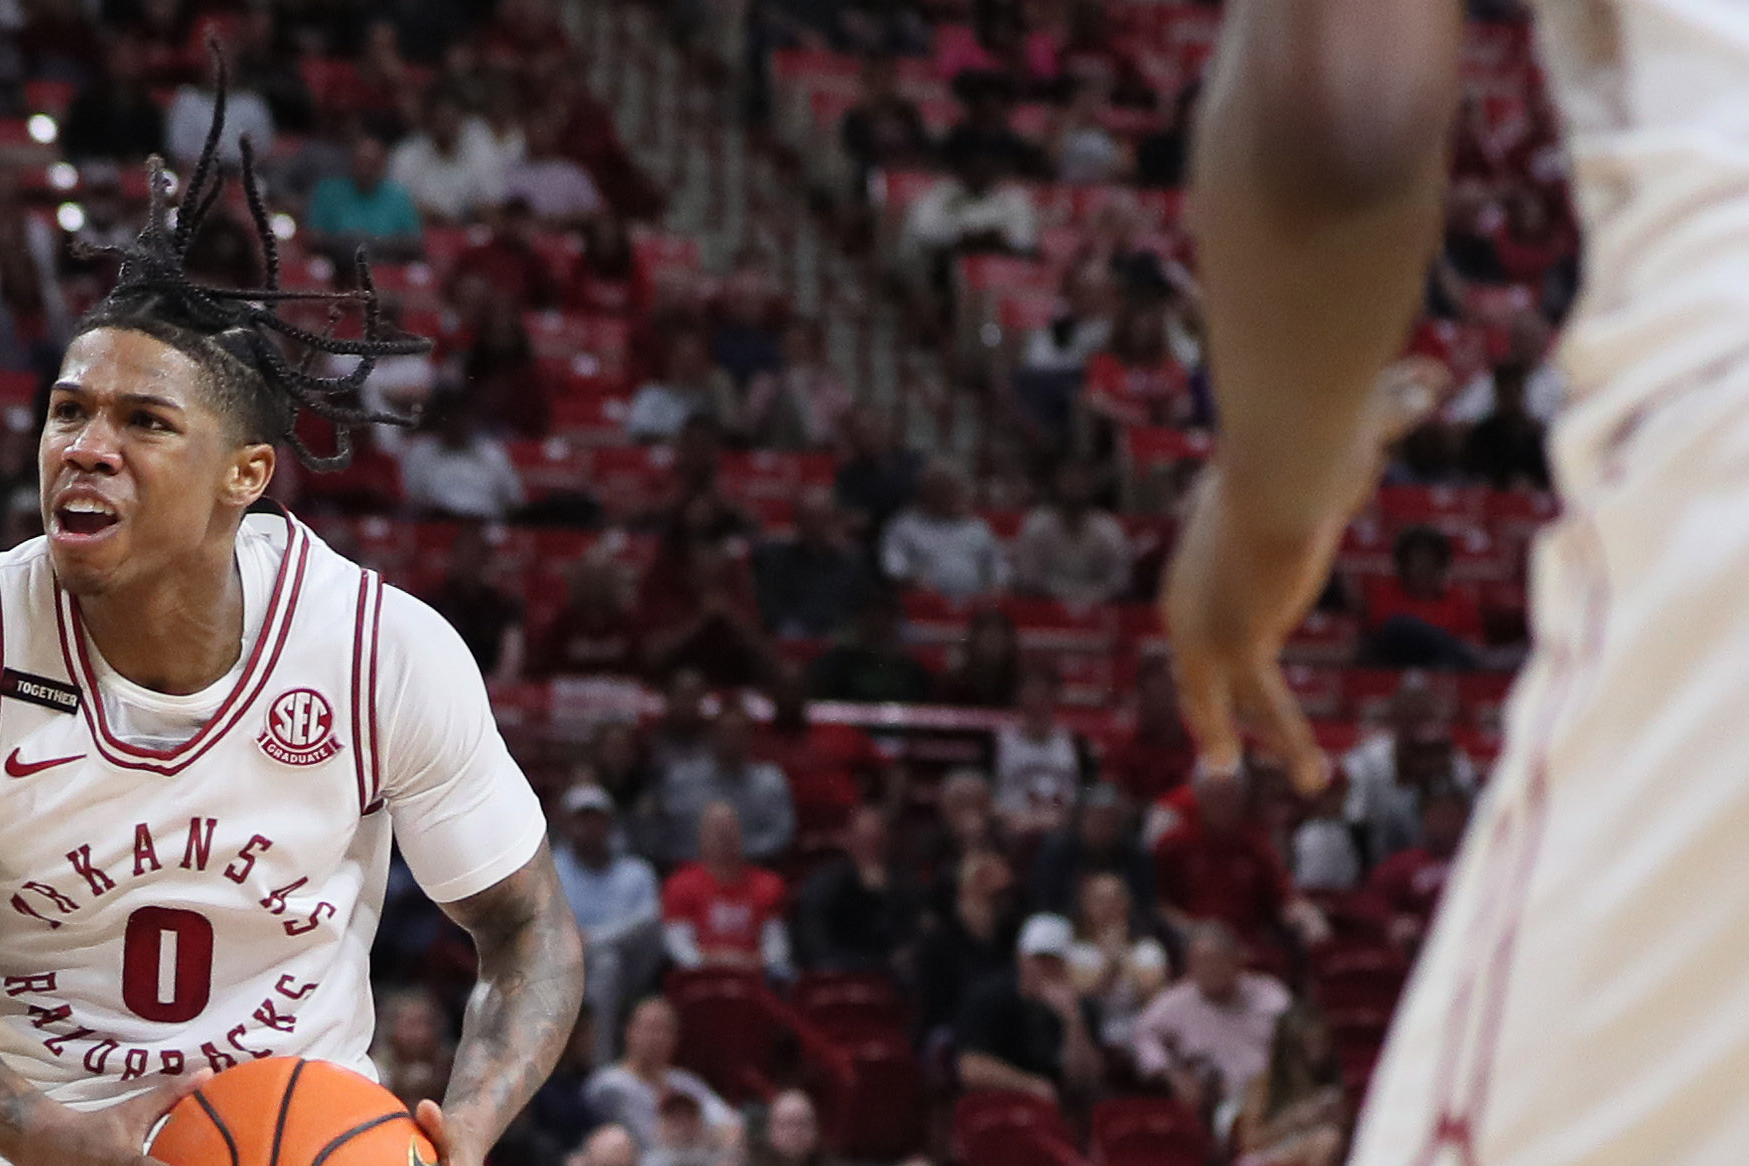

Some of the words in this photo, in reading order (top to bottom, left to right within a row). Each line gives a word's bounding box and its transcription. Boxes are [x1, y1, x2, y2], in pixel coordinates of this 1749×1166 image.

[15, 679, 78, 707] TOGETHER
[273, 692, 329, 746] SEC
[267, 744, 328, 764] GRADUATE
[123, 905, 214, 1023] 0
